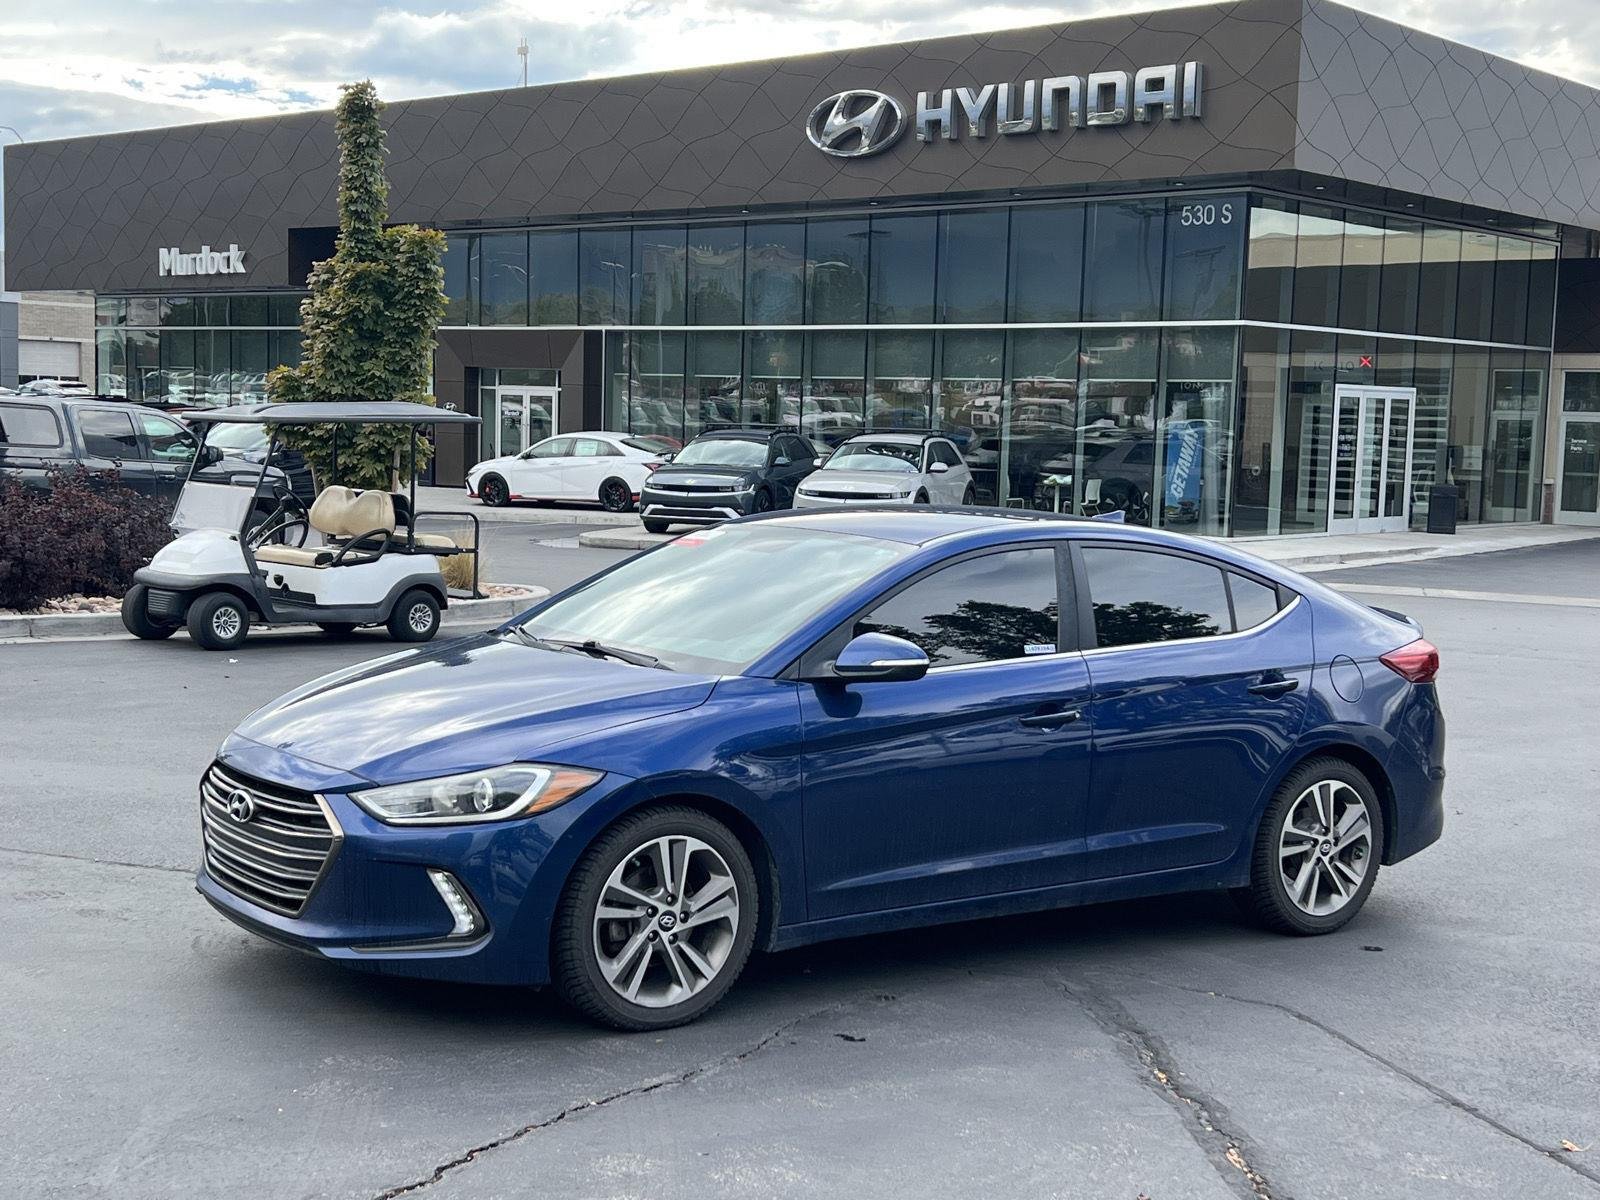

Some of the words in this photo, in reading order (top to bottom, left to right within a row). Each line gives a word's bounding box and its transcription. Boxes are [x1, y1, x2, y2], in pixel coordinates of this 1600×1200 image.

[916, 61, 1201, 143] HYUNDAI
[1181, 205, 1215, 226] 530
[1221, 203, 1232, 224] S
[158, 243, 246, 276] Murdock
